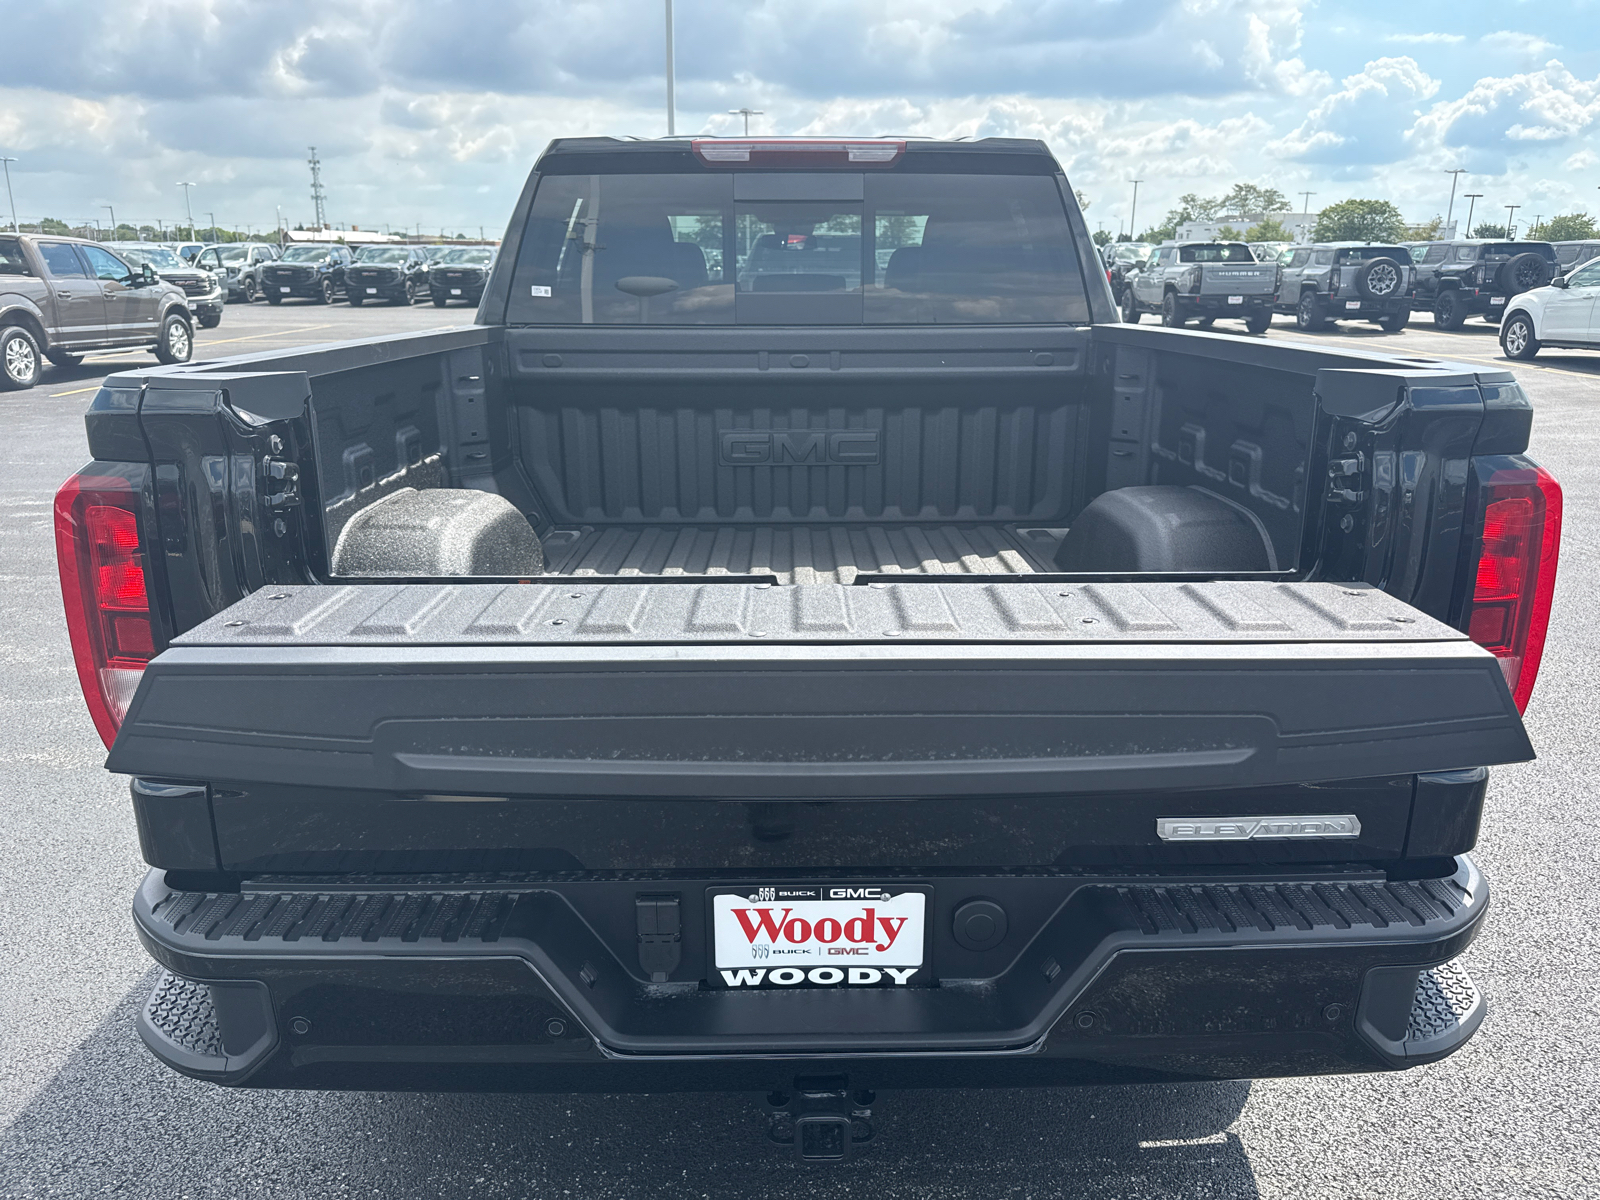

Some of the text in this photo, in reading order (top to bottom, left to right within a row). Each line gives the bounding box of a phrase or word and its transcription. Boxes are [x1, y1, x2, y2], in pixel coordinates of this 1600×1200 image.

[722, 433, 878, 463] GMC
[1172, 820, 1346, 837] ELEVATION
[829, 888, 882, 898] GMC
[730, 908, 909, 952] Woody
[827, 947, 869, 956] GMC
[720, 967, 919, 987] WOODY
